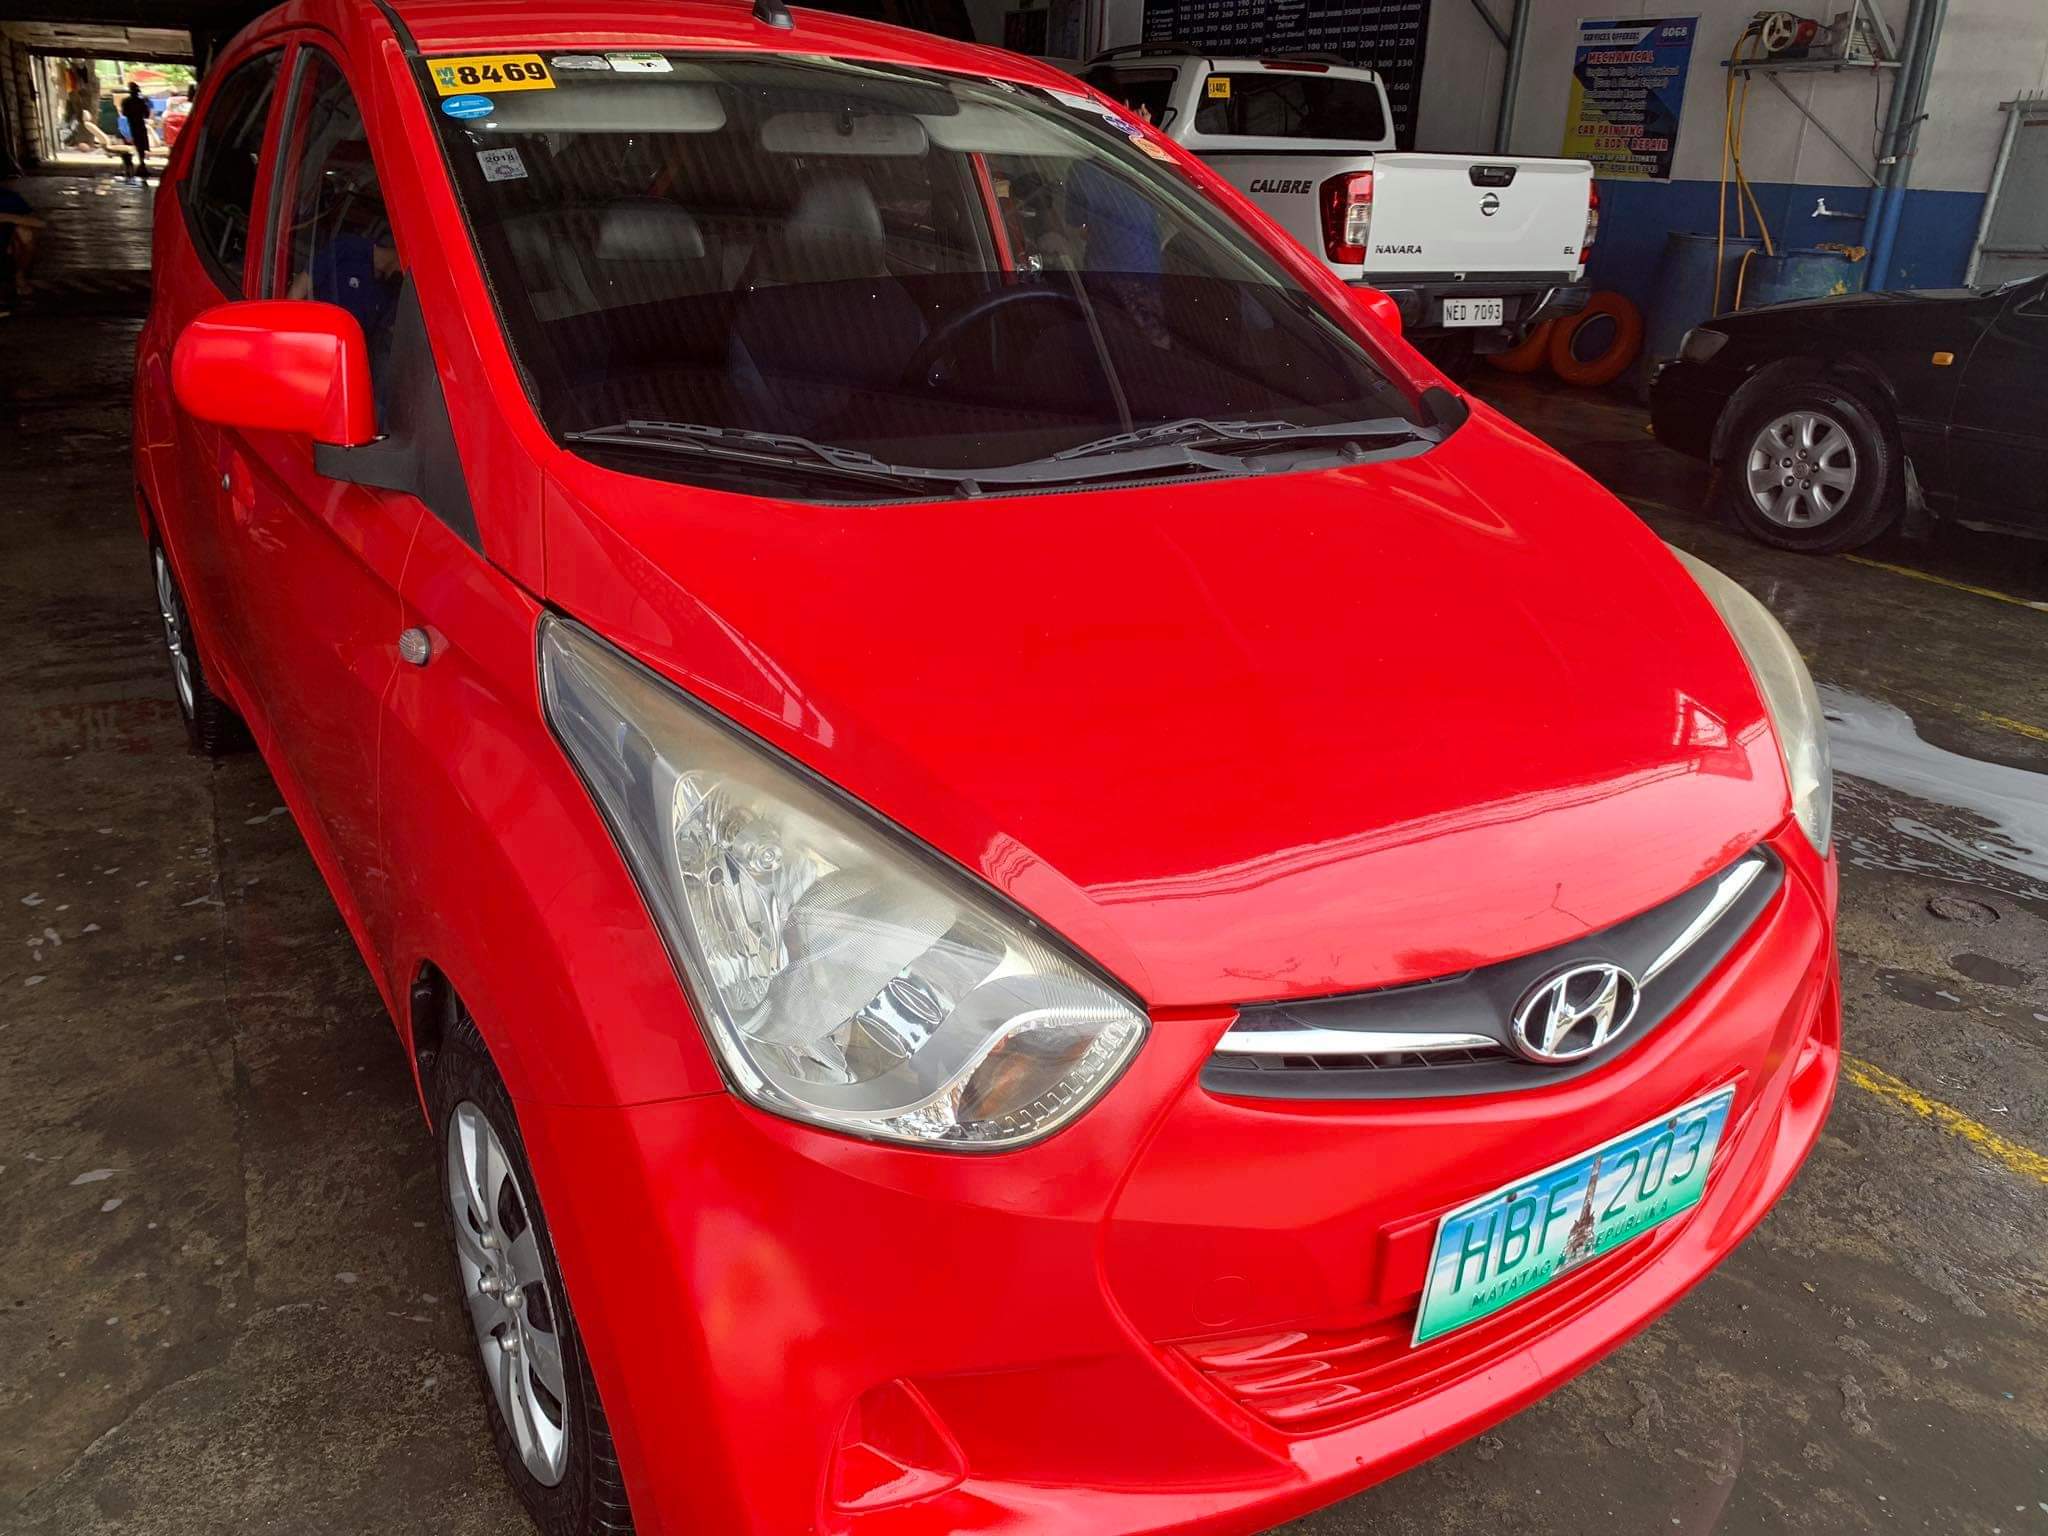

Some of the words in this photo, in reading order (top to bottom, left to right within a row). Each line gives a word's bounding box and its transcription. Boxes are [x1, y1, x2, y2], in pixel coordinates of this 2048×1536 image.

[1396, 59, 1413, 67] 330
[1588, 51, 1655, 64] MECHANICAL
[457, 62, 548, 85] 8469
[1393, 82, 1410, 91] 660
[1578, 125, 1595, 136] CAR
[1597, 125, 1644, 137] PAINTING
[1631, 138, 1669, 151] REPAIR
[1250, 179, 1312, 194] CALIBRE
[1375, 244, 1422, 254] NAVARA
[1564, 246, 1575, 255] EL
[1446, 304, 1466, 321] NED
[1474, 304, 1501, 320] 7093
[1452, 1175, 1579, 1294] HBF
[1600, 1115, 1708, 1221] 203
[1472, 1259, 1552, 1309] MATATAG
